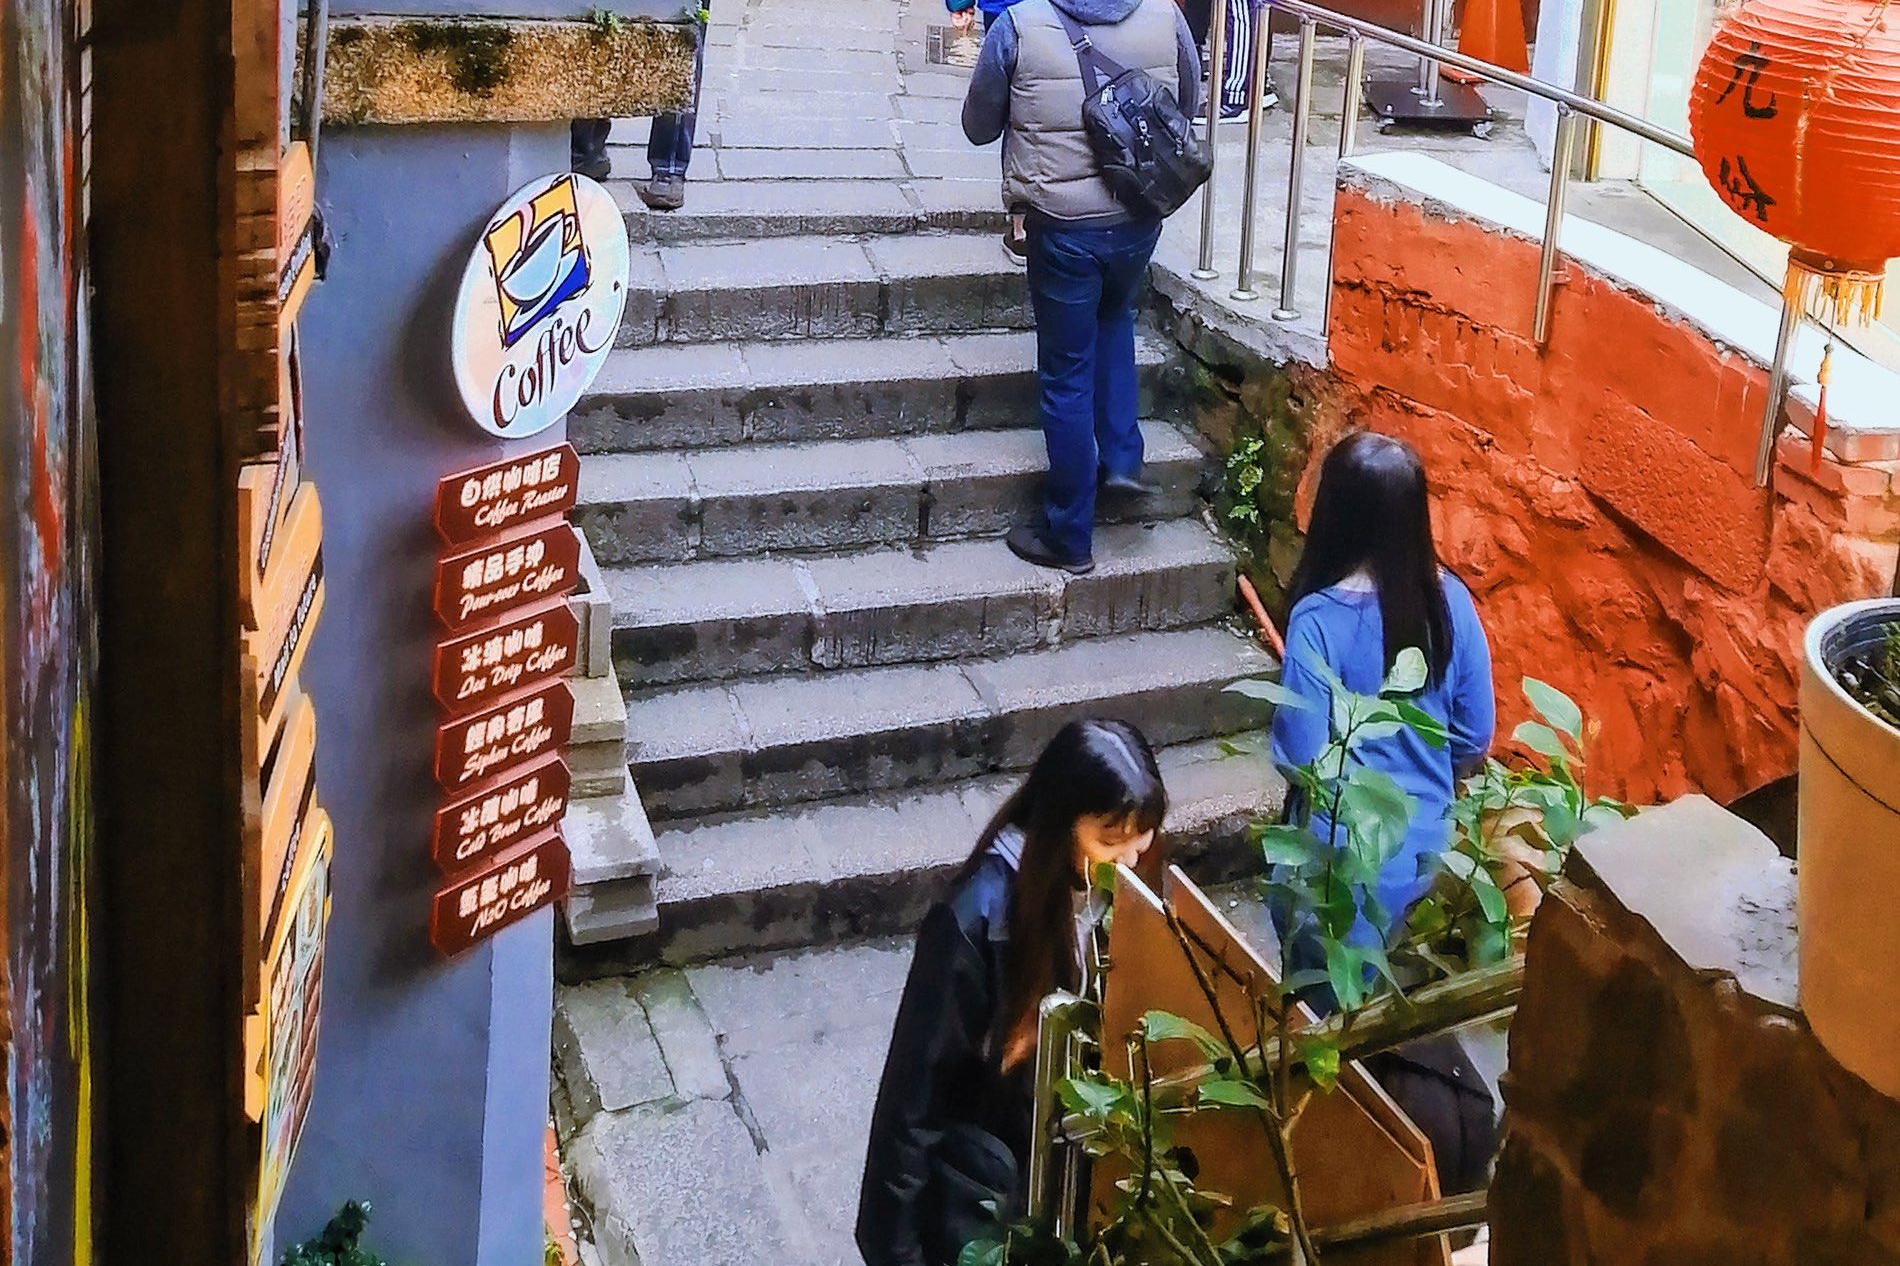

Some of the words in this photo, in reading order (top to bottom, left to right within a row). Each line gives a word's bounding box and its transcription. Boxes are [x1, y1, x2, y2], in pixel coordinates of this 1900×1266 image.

[493, 300, 622, 429] Coffee
[460, 452, 563, 508] 自烘咖啡店
[474, 499, 518, 527] Coffee
[522, 564, 565, 593] Coffee
[525, 643, 567, 673] Coffee
[511, 726, 553, 754] Coffee
[523, 794, 563, 826] Coffee
[509, 878, 552, 910] Coffee
